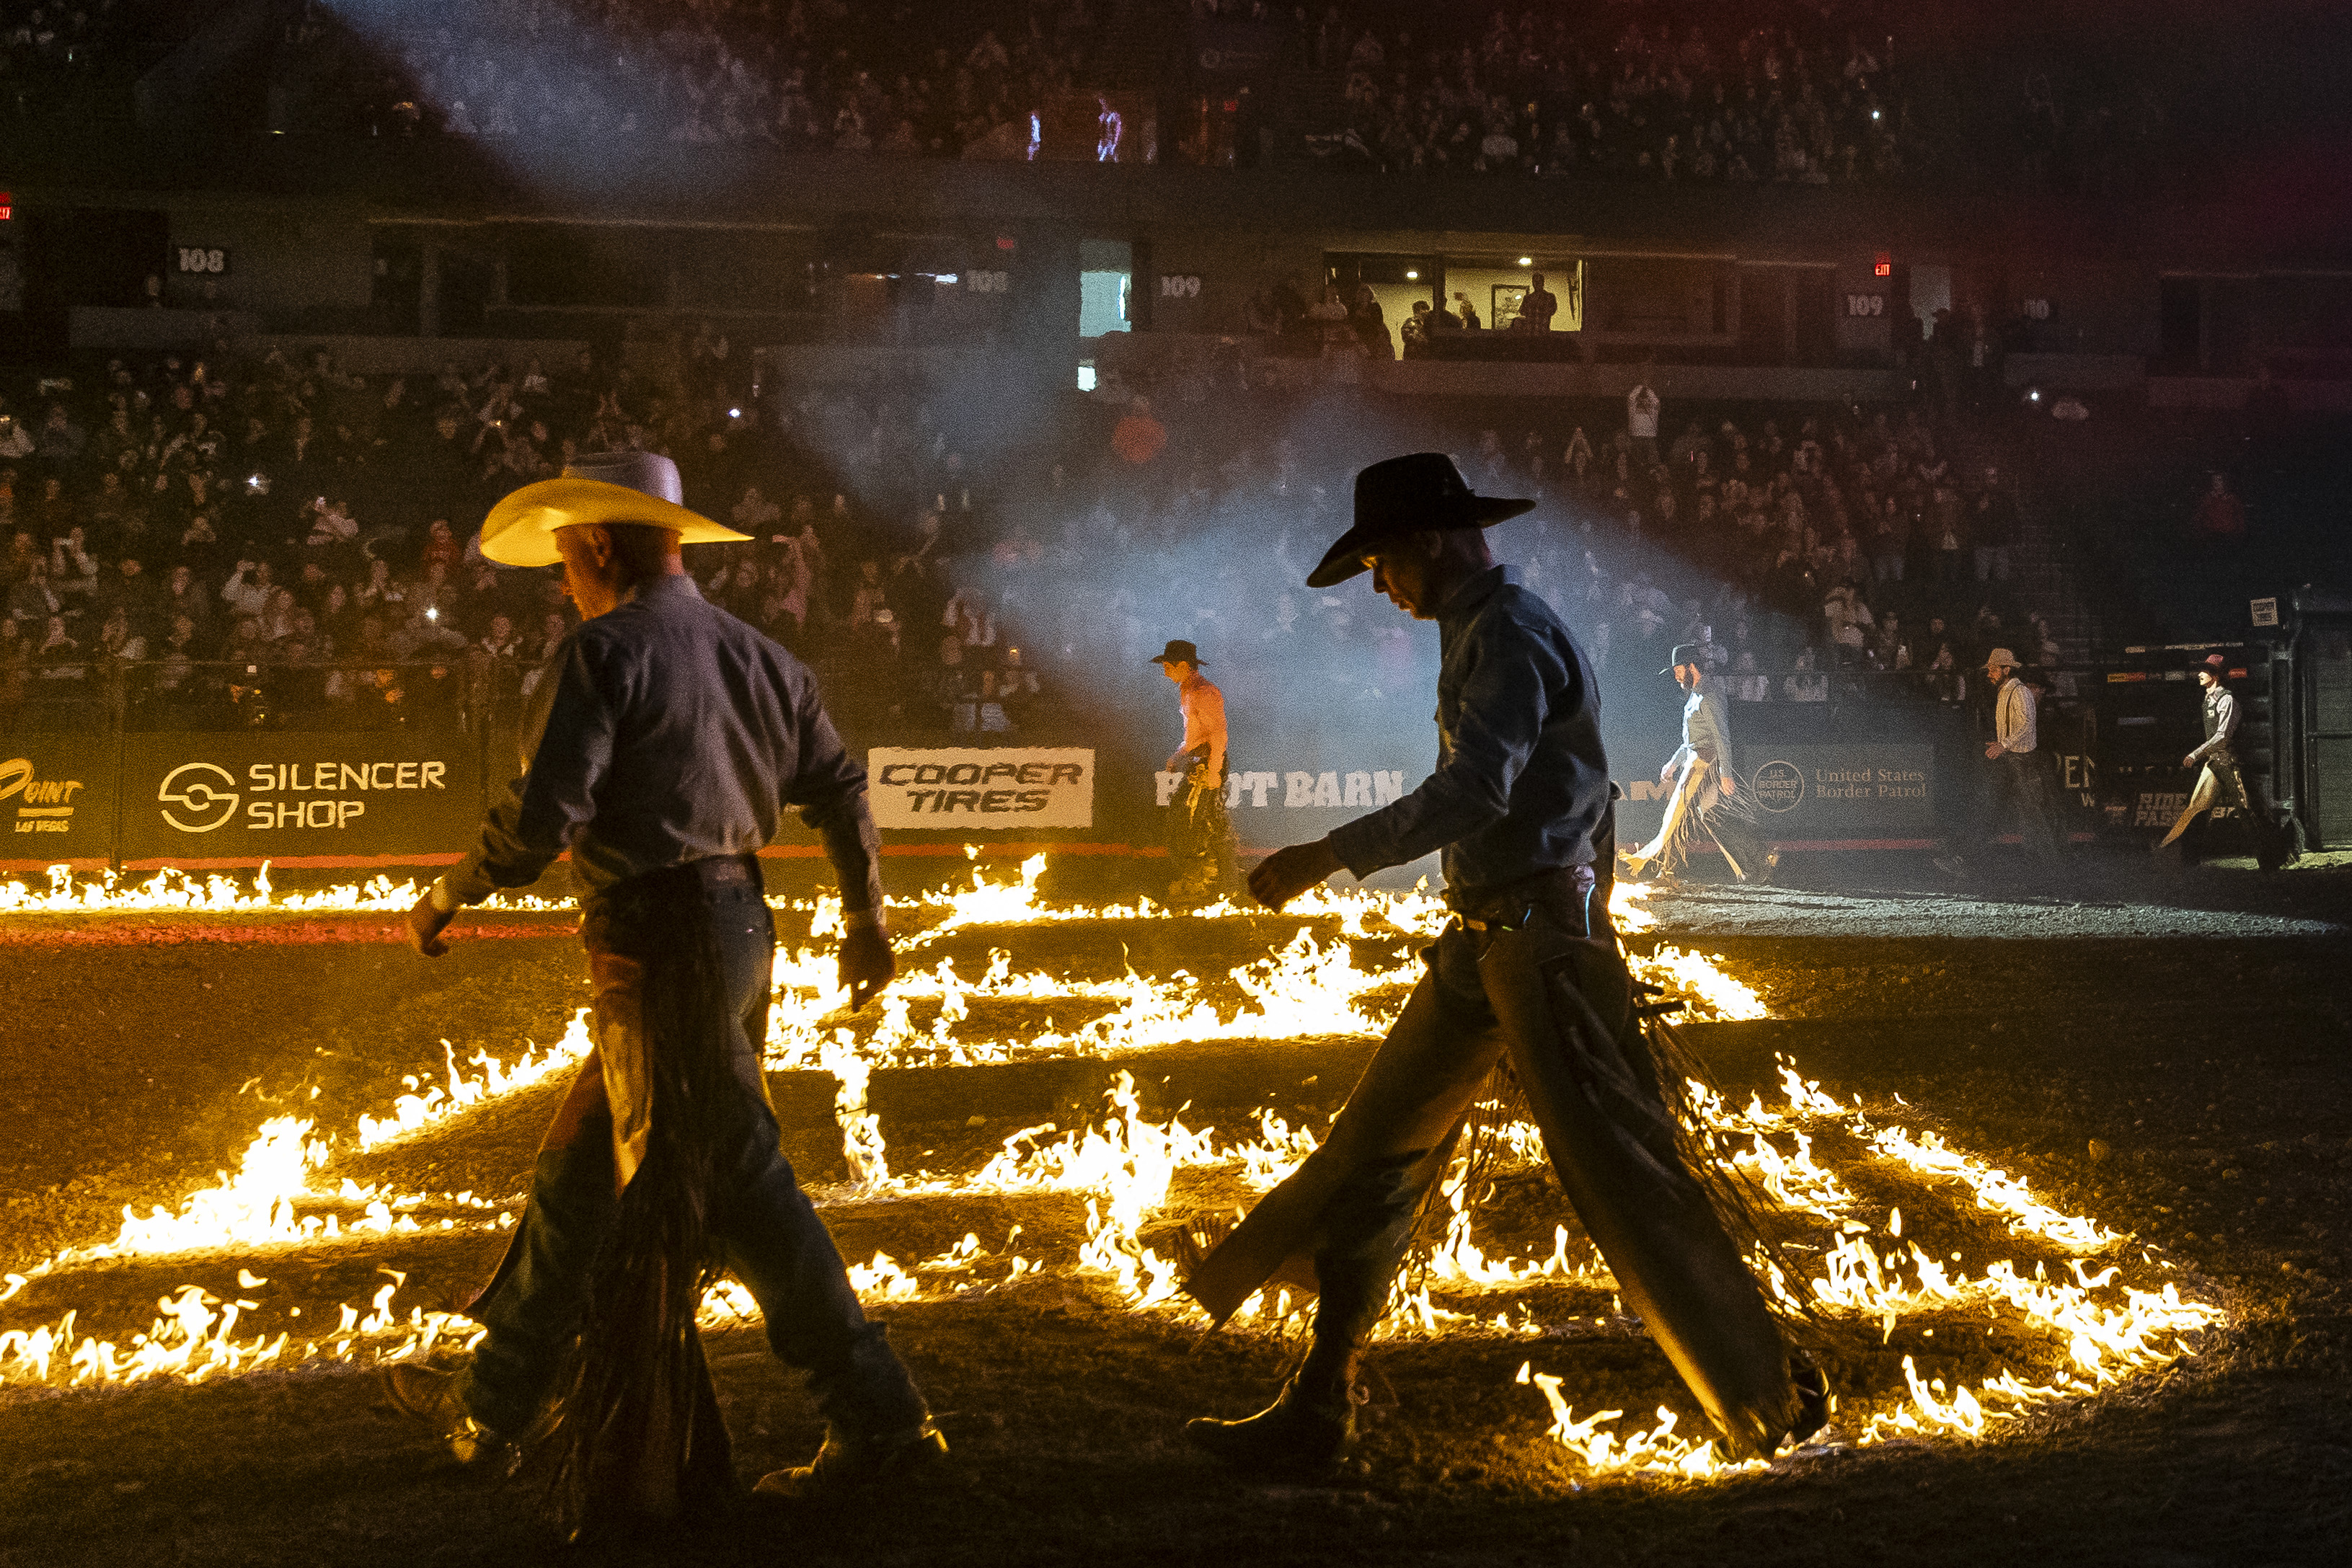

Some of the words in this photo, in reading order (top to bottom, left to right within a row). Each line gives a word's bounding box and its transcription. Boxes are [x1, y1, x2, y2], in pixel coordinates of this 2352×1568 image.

[178, 248, 224, 273] 108
[1875, 264, 1890, 275] EXIT
[1161, 275, 1201, 297] 109
[1847, 295, 1883, 316] 109
[248, 761, 446, 792] SILENCER
[879, 762, 1083, 787] COOPER
[1759, 779, 1798, 789] BORDER
[1816, 769, 1871, 782] United
[1878, 769, 1925, 782] States
[1283, 770, 1405, 807] BARN
[1759, 789, 1796, 799] PATROL
[1816, 784, 1871, 798] Border
[1878, 784, 1927, 798] Patrol
[906, 789, 1051, 813] TIRES
[2137, 793, 2188, 810] RIDE
[247, 800, 365, 830] SHOP
